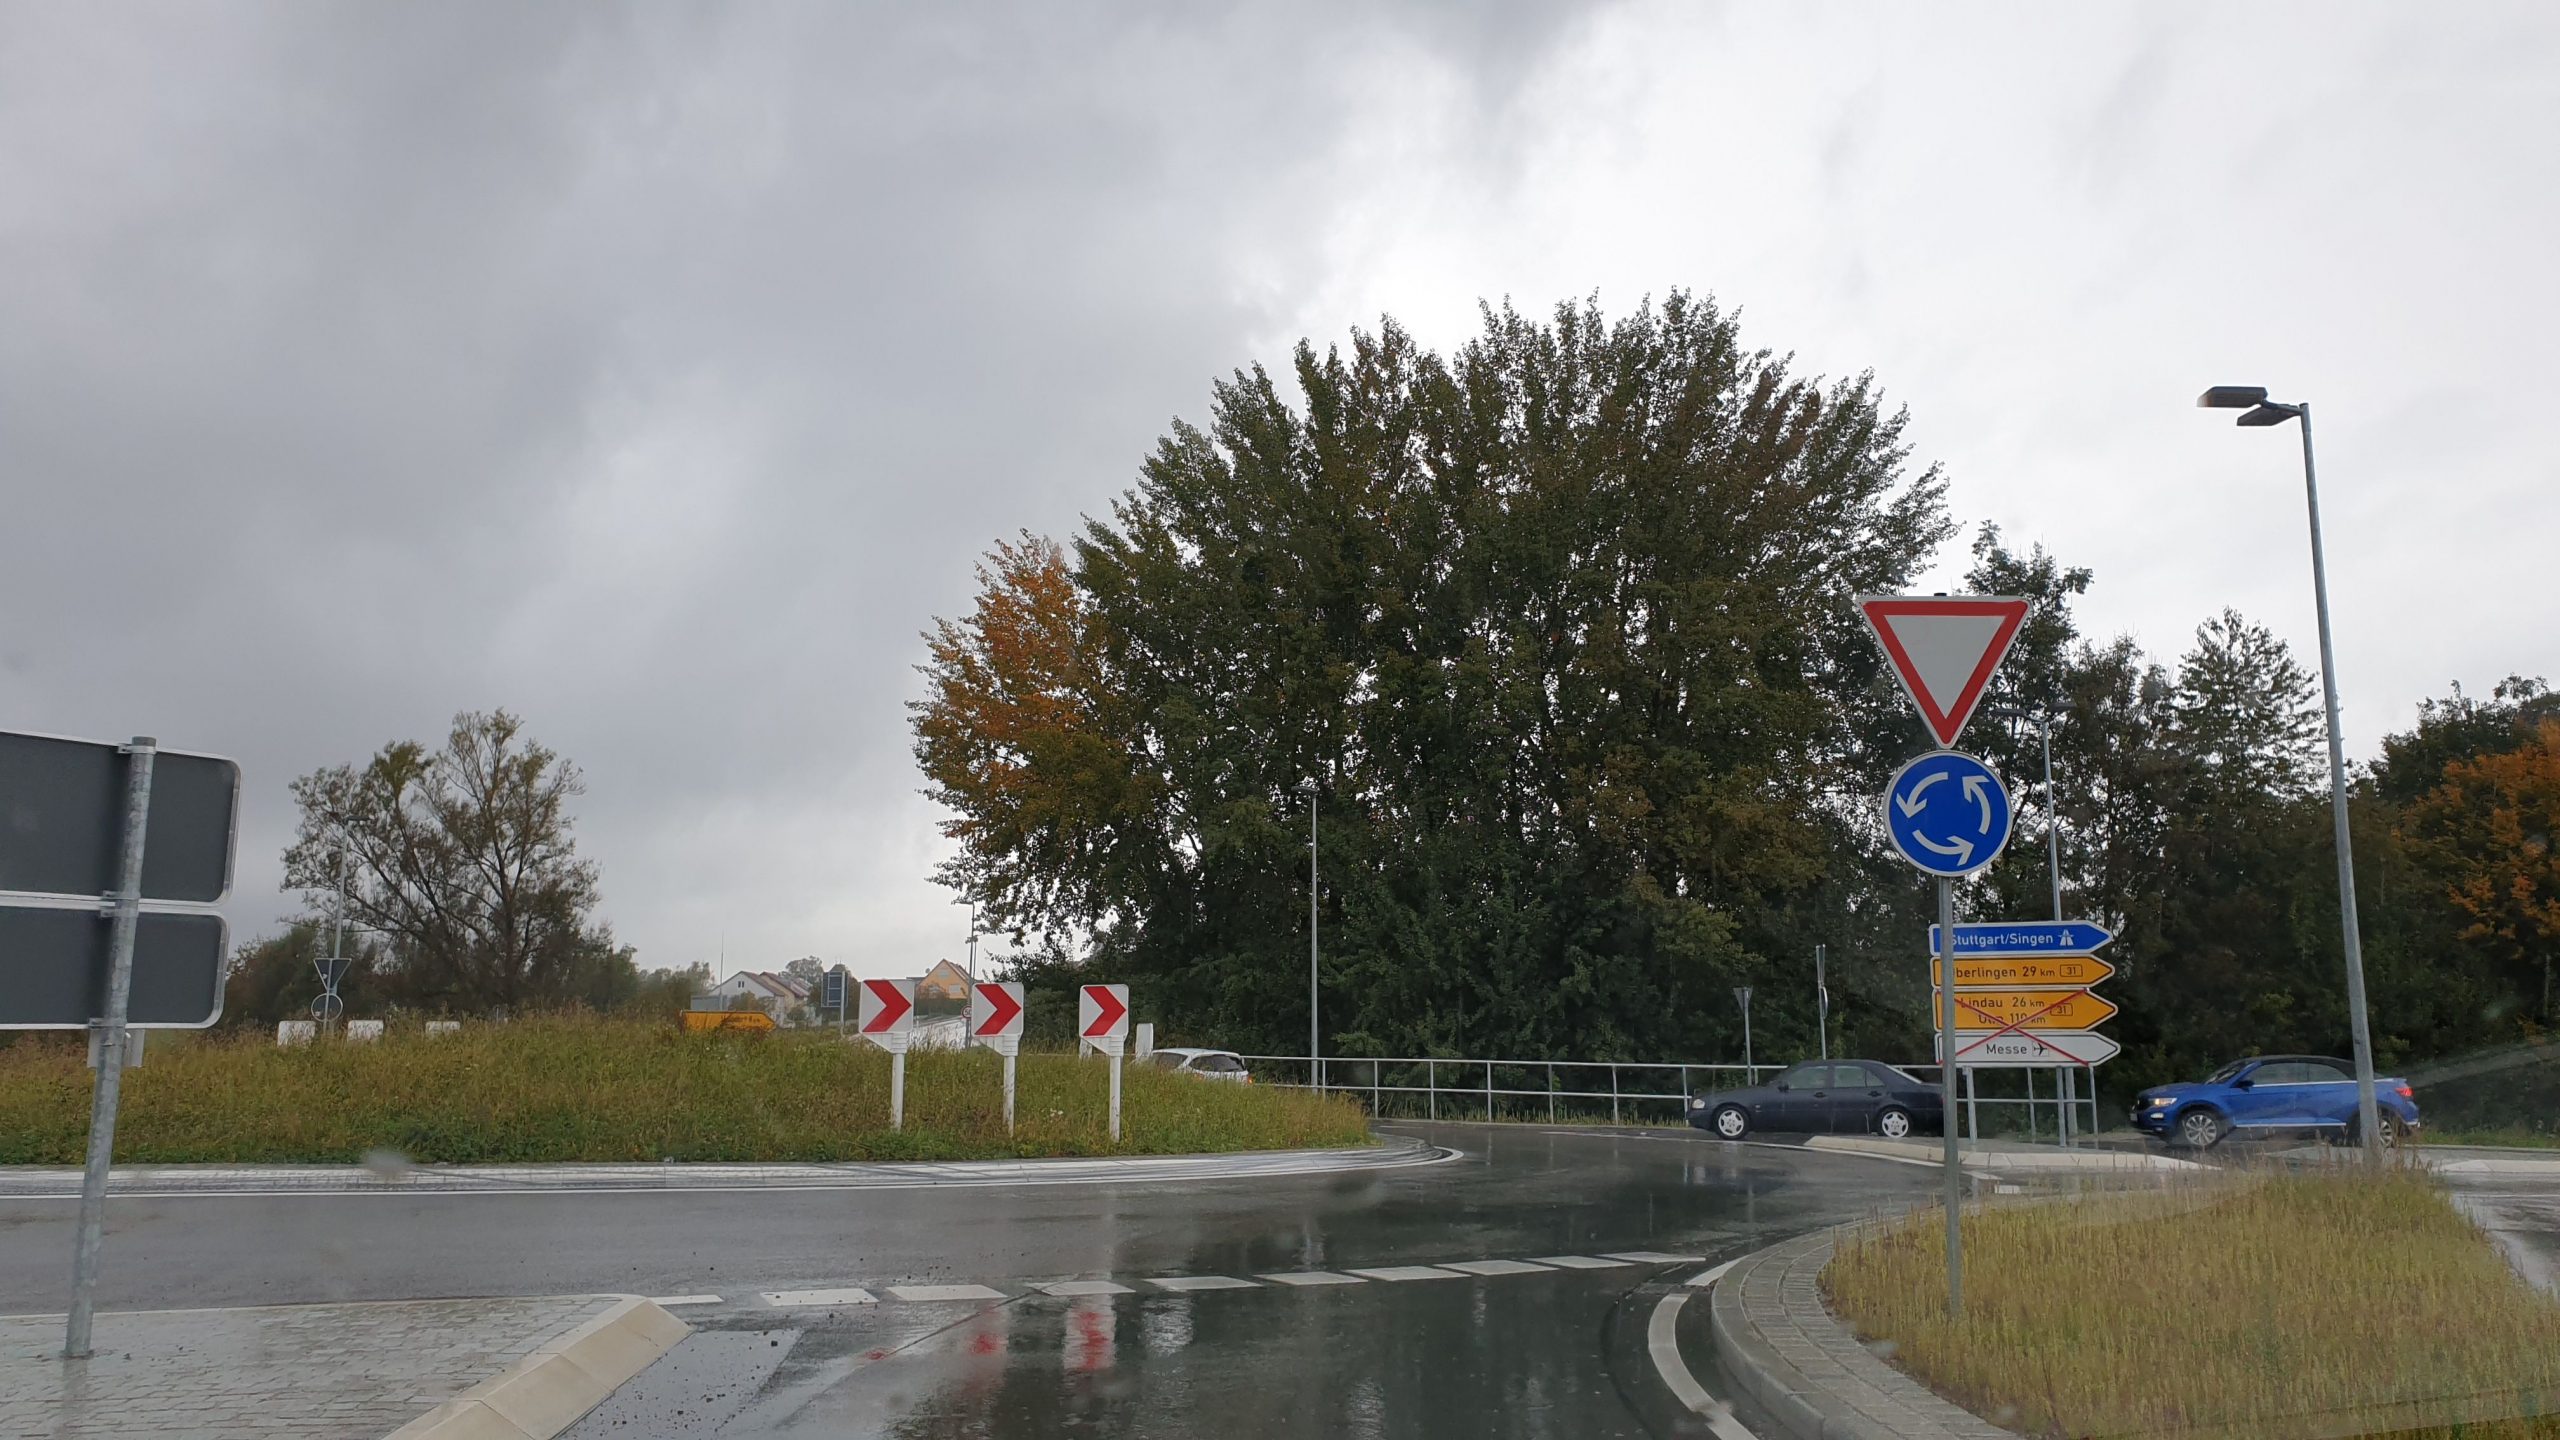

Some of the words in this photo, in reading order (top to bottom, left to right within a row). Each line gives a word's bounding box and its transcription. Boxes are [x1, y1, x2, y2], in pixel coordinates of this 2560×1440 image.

[1953, 967, 2017, 980] berlingen
[2022, 965, 2037, 978] 29
[2040, 968, 2056, 977] km
[2065, 966, 2077, 976] 31
[1960, 997, 2003, 1008] Lindau
[2012, 996, 2027, 1009] 26
[2030, 999, 2045, 1008] km
[1986, 1043, 2028, 1055] Messe
